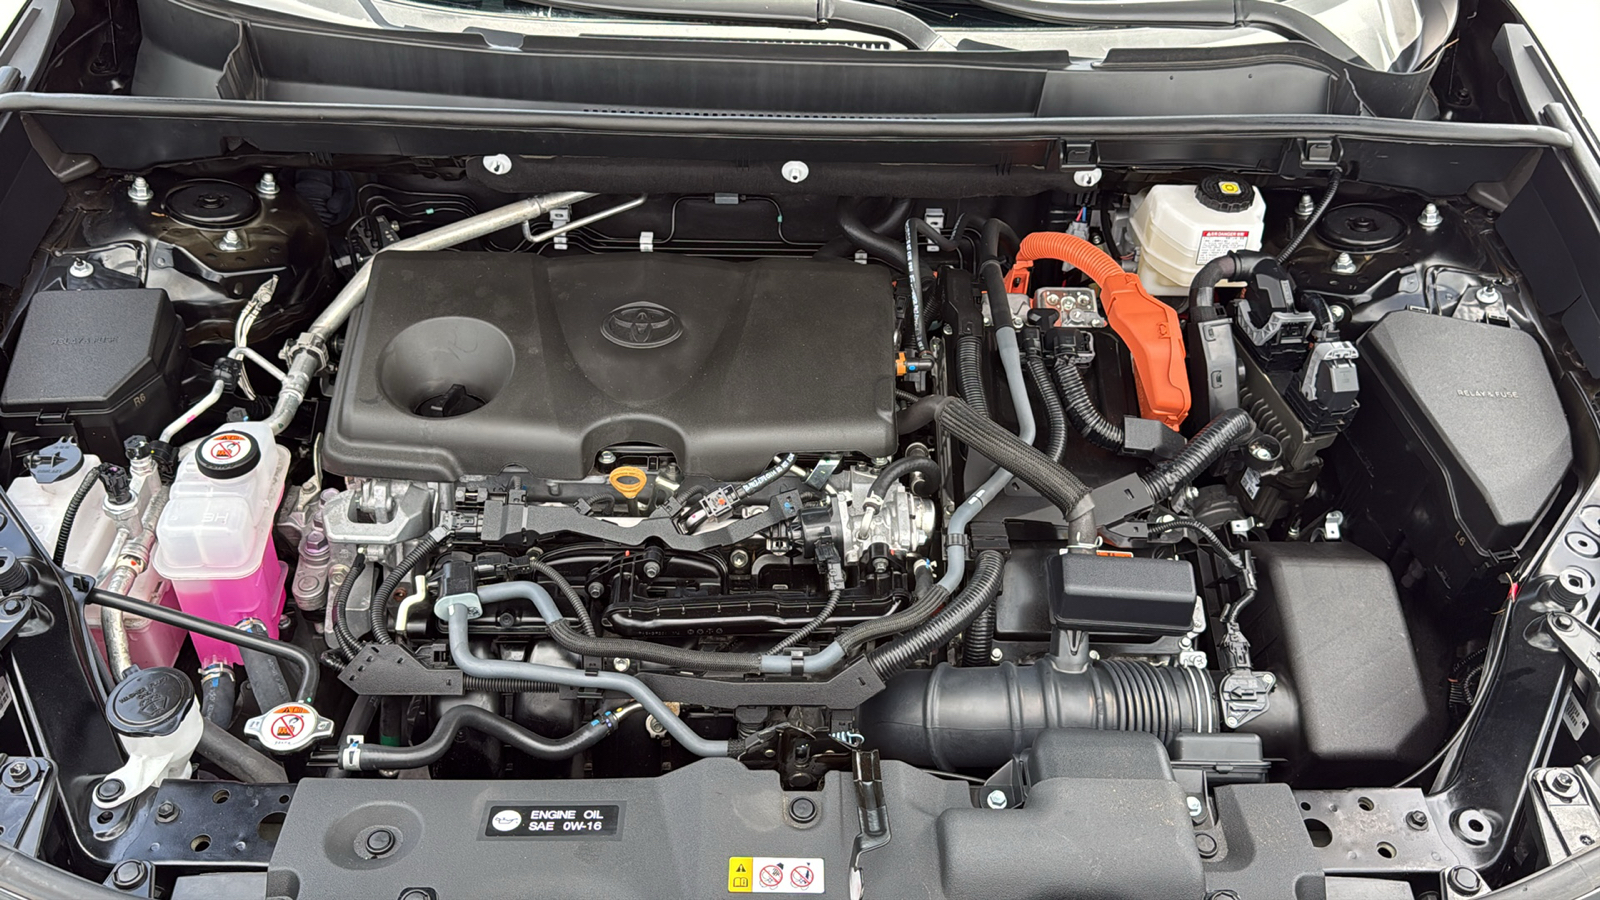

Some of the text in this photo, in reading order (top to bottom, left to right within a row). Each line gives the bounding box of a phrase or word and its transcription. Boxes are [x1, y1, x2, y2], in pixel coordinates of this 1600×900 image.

[1456, 389, 1486, 397] RELAY
[1494, 391, 1519, 399] FUSE
[133, 393, 146, 407] R6
[1455, 530, 1466, 547] L6
[530, 810, 604, 820] ENGINE OIL
[528, 821, 602, 831] SAE 0W-16
